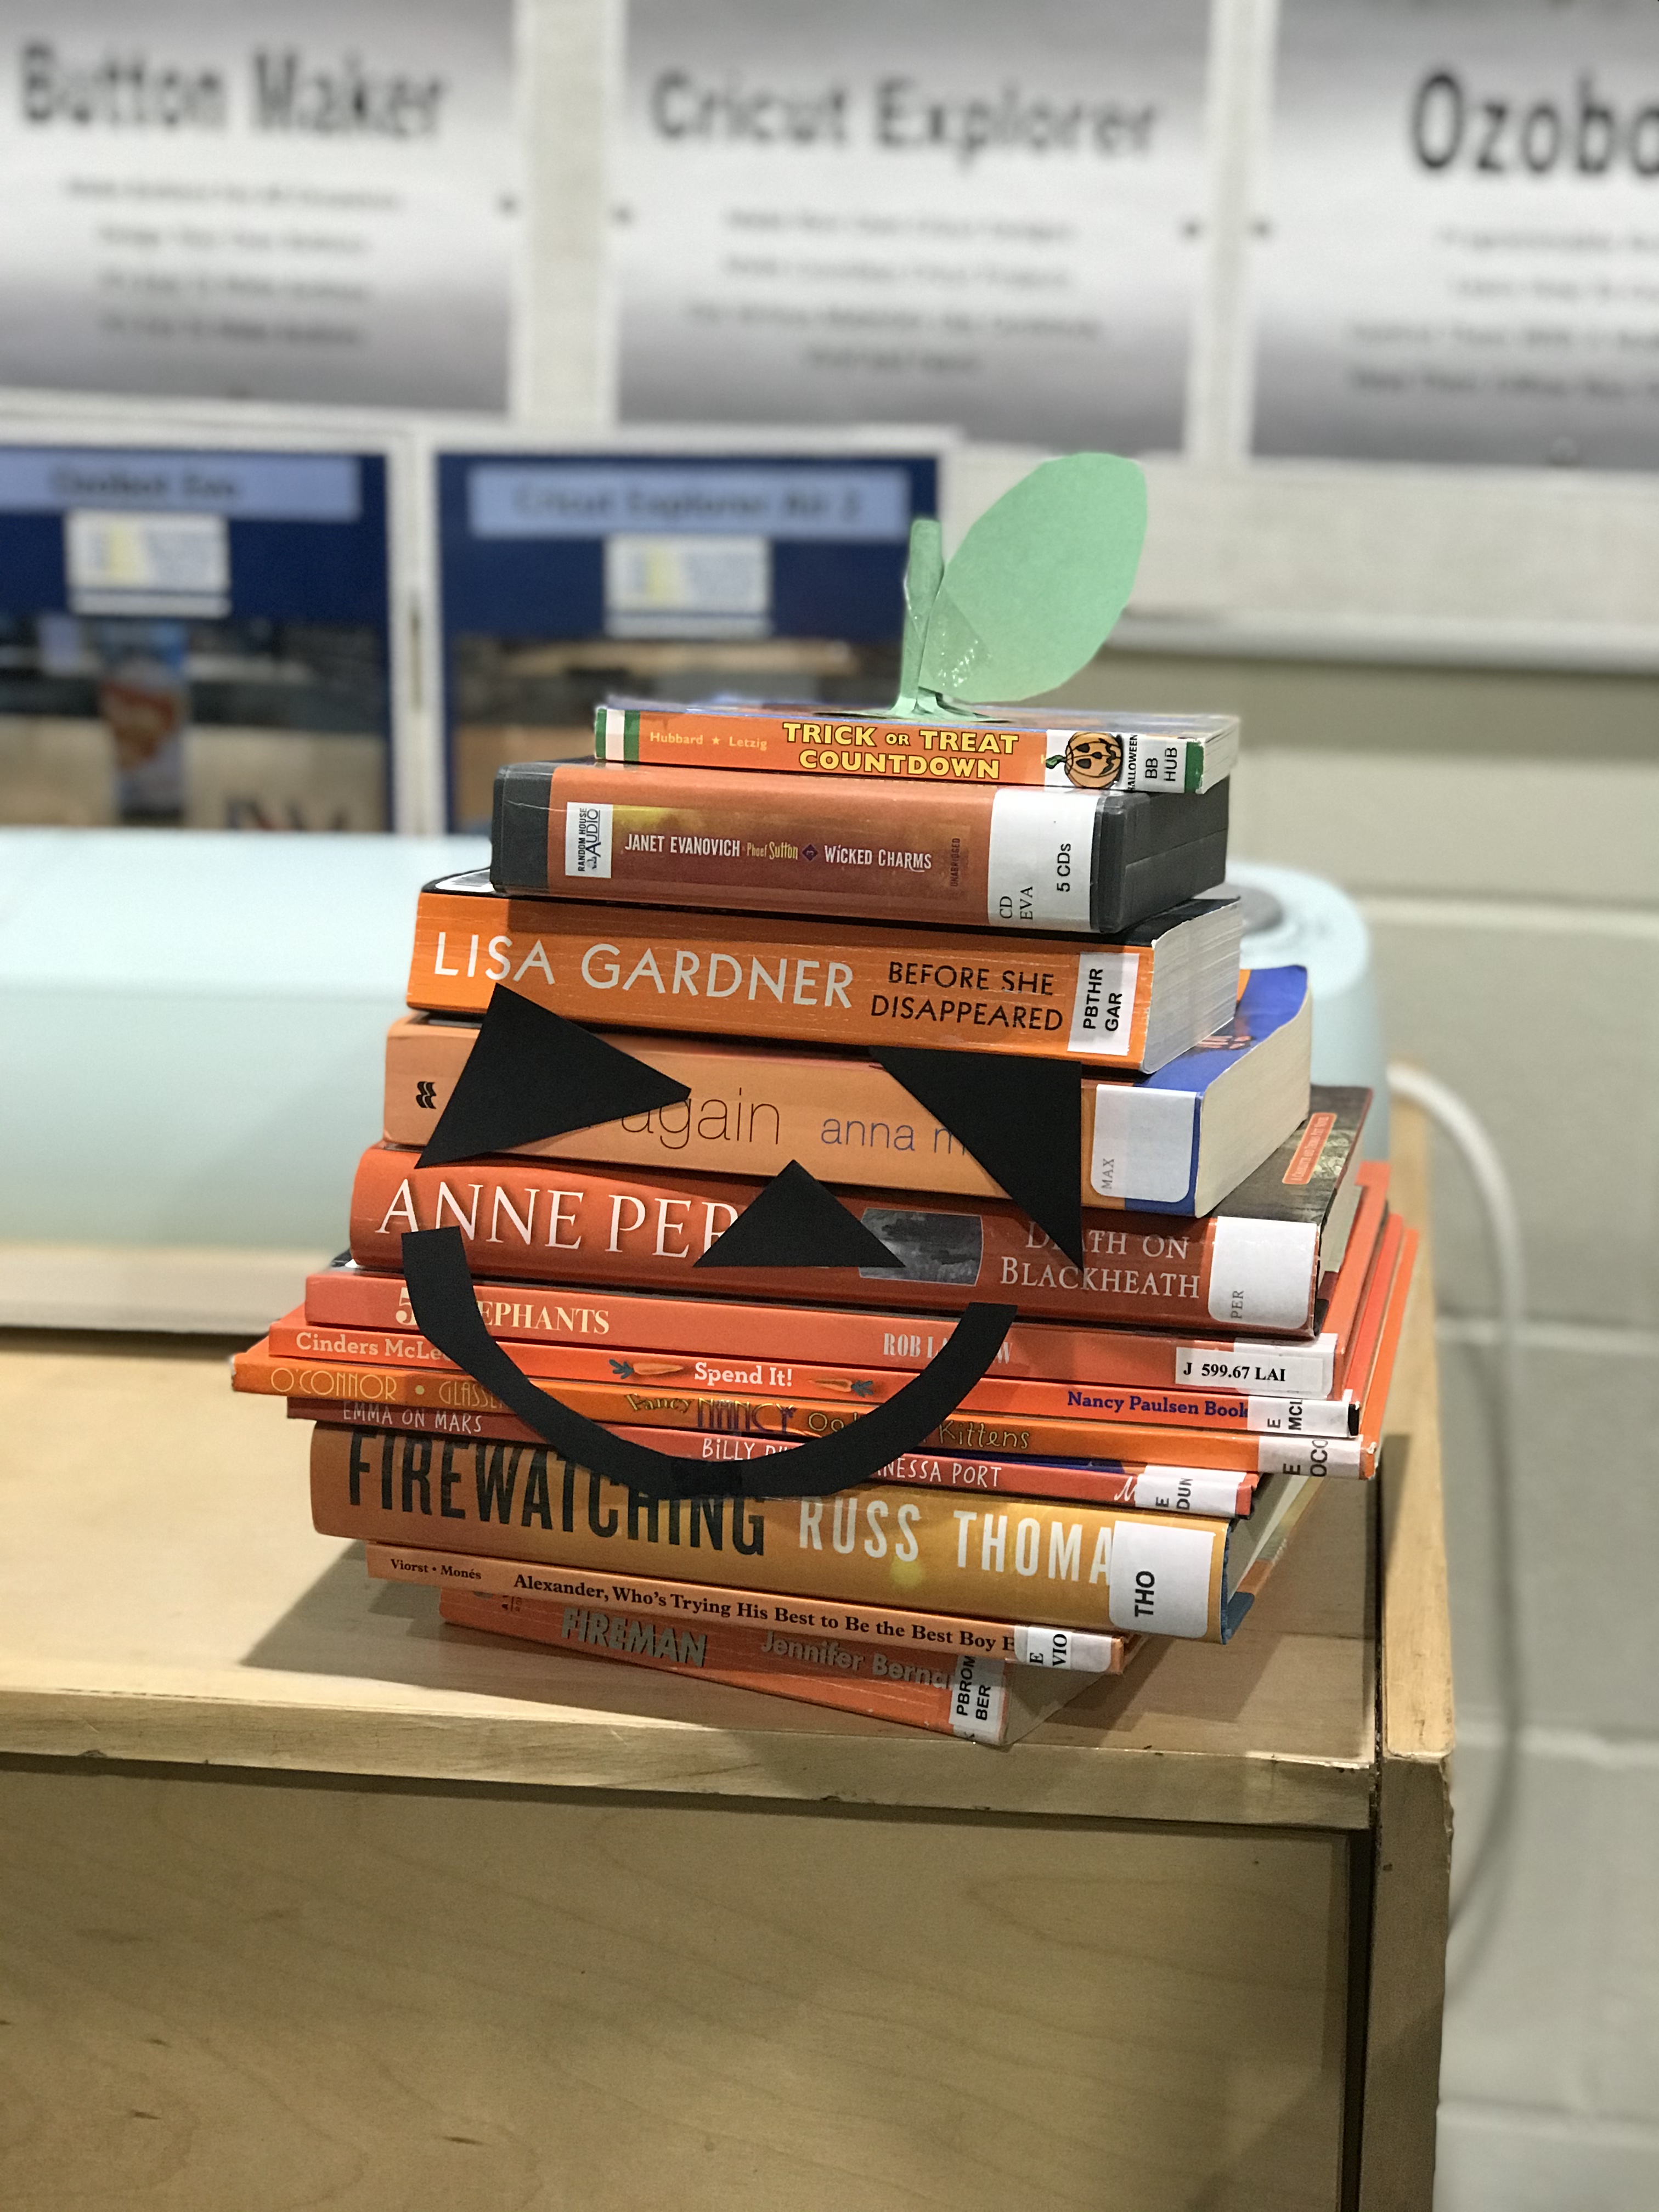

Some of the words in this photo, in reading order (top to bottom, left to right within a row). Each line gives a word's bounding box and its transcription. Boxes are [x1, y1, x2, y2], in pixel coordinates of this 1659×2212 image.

[650, 731, 703, 745] Hubbard
[729, 736, 768, 751] Letzig
[783, 722, 877, 747] TRICK
[885, 733, 911, 746] OR
[919, 730, 1019, 754] TREAT
[799, 749, 1000, 780] COUNTDOWN
[1127, 734, 1138, 791] HALLOWEEN
[1145, 757, 1159, 779] BB
[1164, 747, 1178, 782] HUB
[579, 808, 587, 835] HOUSE
[585, 808, 601, 857] AUDIO
[578, 837, 586, 872] RANDOM
[625, 833, 665, 853] JANET
[670, 836, 741, 857] EVANOVICH
[746, 842, 768, 857] Phoef
[769, 841, 798, 860] Sutton
[878, 849, 932, 873] CHARMS
[950, 838, 960, 887] UNABRIDGED
[1020, 886, 1034, 920] EVA
[1057, 882, 1070, 892] 5
[1000, 895, 1013, 919] CD
[433, 931, 556, 986] LISA
[581, 943, 854, 1009] GARDNER
[889, 961, 990, 990] BEFORE
[1001, 969, 1054, 996] SHE
[871, 995, 1063, 1031] DISAPPEARED
[1082, 968, 1103, 1029] PBTHR
[1105, 992, 1123, 1031] GAR
[821, 1118, 916, 1151] anna
[1101, 1158, 1115, 1189] MAX
[375, 1178, 585, 1250] ANNE
[605, 1194, 739, 1260] PER
[1025, 1221, 1128, 1255] DTH
[1142, 1234, 1190, 1260] ON
[1001, 1256, 1200, 1300] BLACKHEATH
[477, 1300, 610, 1335] EPHANTS
[1231, 1289, 1245, 1319] PER
[296, 1331, 379, 1356] Cinders
[385, 1338, 451, 1362] McLe
[883, 1332, 922, 1357] ROB
[270, 1367, 397, 1401] O'CONNOR
[695, 1361, 763, 1386] Spend
[769, 1367, 793, 1387] It!
[1183, 1362, 1193, 1375] J
[1201, 1363, 1250, 1379] 599.67
[1255, 1367, 1286, 1381] LAI
[343, 1400, 393, 1425] EMMA
[402, 1407, 425, 1427] ON
[435, 1410, 483, 1434] MARS
[625, 1393, 695, 1413] Fancy
[697, 1397, 798, 1434] NANCY
[1067, 1391, 1124, 1413] Nancy
[1128, 1395, 1199, 1415] Paulsen
[1204, 1400, 1248, 1418] Book
[939, 1419, 1030, 1449] Kittens
[1267, 1418, 1281, 1429] E
[952, 1462, 1002, 1488] PORT
[1283, 1463, 1301, 1476] E
[349, 1429, 765, 1557] FIREWATCHING
[799, 1496, 922, 1562] RUSS
[953, 1509, 1113, 1587] THOMA
[1155, 1496, 1170, 1508] E
[1176, 1477, 1194, 1510] DUN
[390, 1559, 428, 1573] Viorst
[441, 1564, 482, 1581] Monés
[1134, 1570, 1155, 1618] THO
[514, 1573, 609, 1602] Alexander,
[613, 1584, 667, 1607] Who's
[670, 1593, 731, 1618] Trying
[736, 1602, 769, 1620] His
[774, 1607, 815, 1627] Best
[821, 1615, 839, 1629] to
[845, 1616, 871, 1633] Be
[875, 1621, 905, 1638] the
[912, 1624, 953, 1644] Best
[960, 1630, 997, 1652] Boy
[561, 1607, 708, 1668] FIREMAN
[761, 1631, 865, 1671] Jennifer
[1052, 1633, 1068, 1667] VIO
[1029, 1652, 1044, 1664] E
[956, 1655, 976, 1716] PBROM
[975, 1684, 991, 1721] BER
